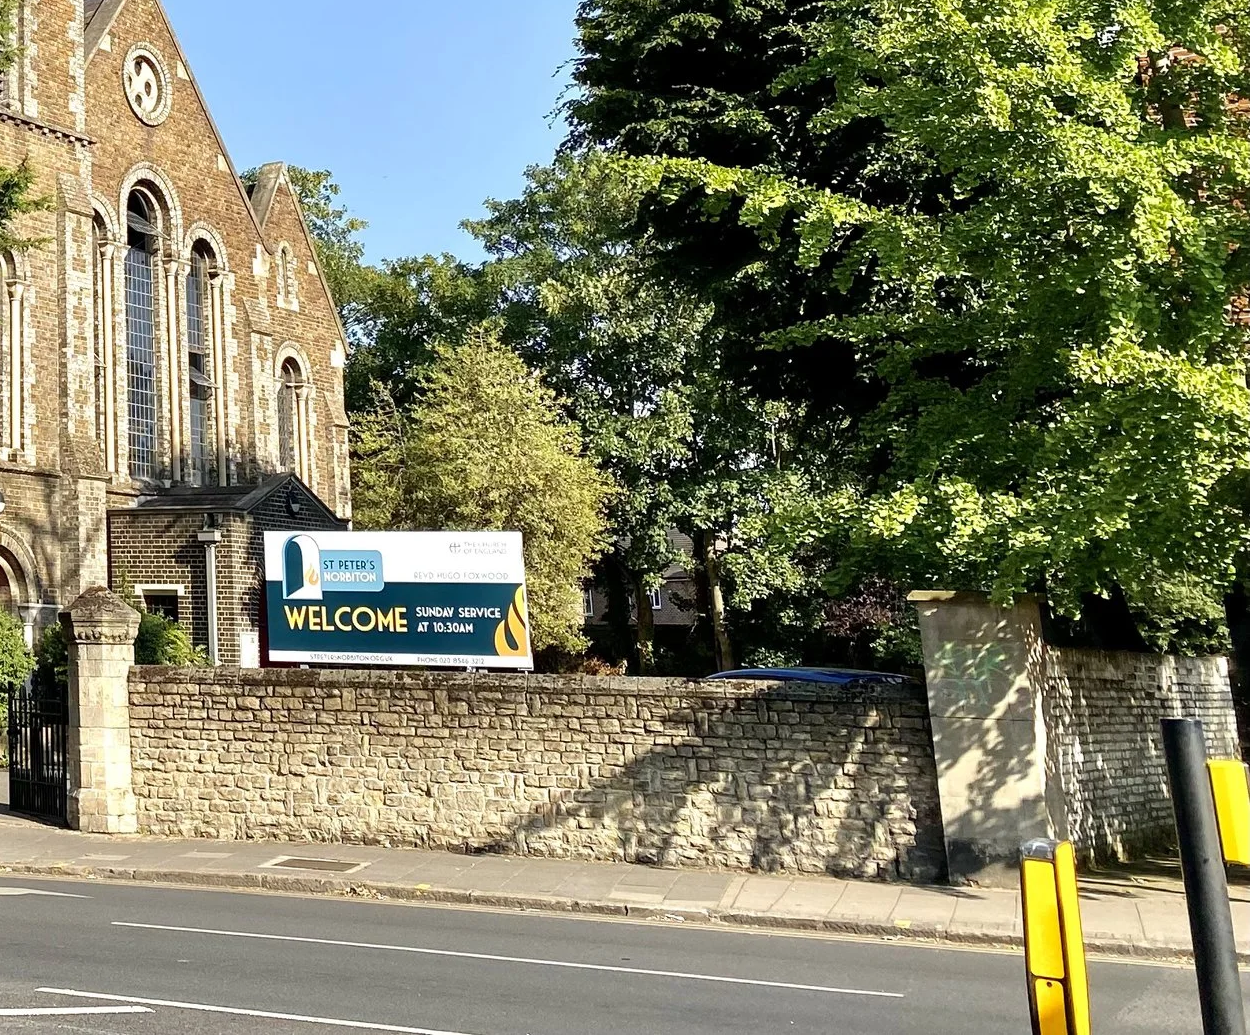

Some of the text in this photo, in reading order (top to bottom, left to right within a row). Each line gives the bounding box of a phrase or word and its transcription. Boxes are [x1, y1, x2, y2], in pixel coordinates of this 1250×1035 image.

[323, 559, 376, 570] ST PETER'S
[323, 571, 377, 583] NORBITON
[413, 571, 509, 581] REVD HUGO FOXWOOD
[415, 606, 502, 619] SUNDAY SERVICE
[283, 605, 408, 633] WELCOME
[417, 621, 474, 634] AT 10:30AM
